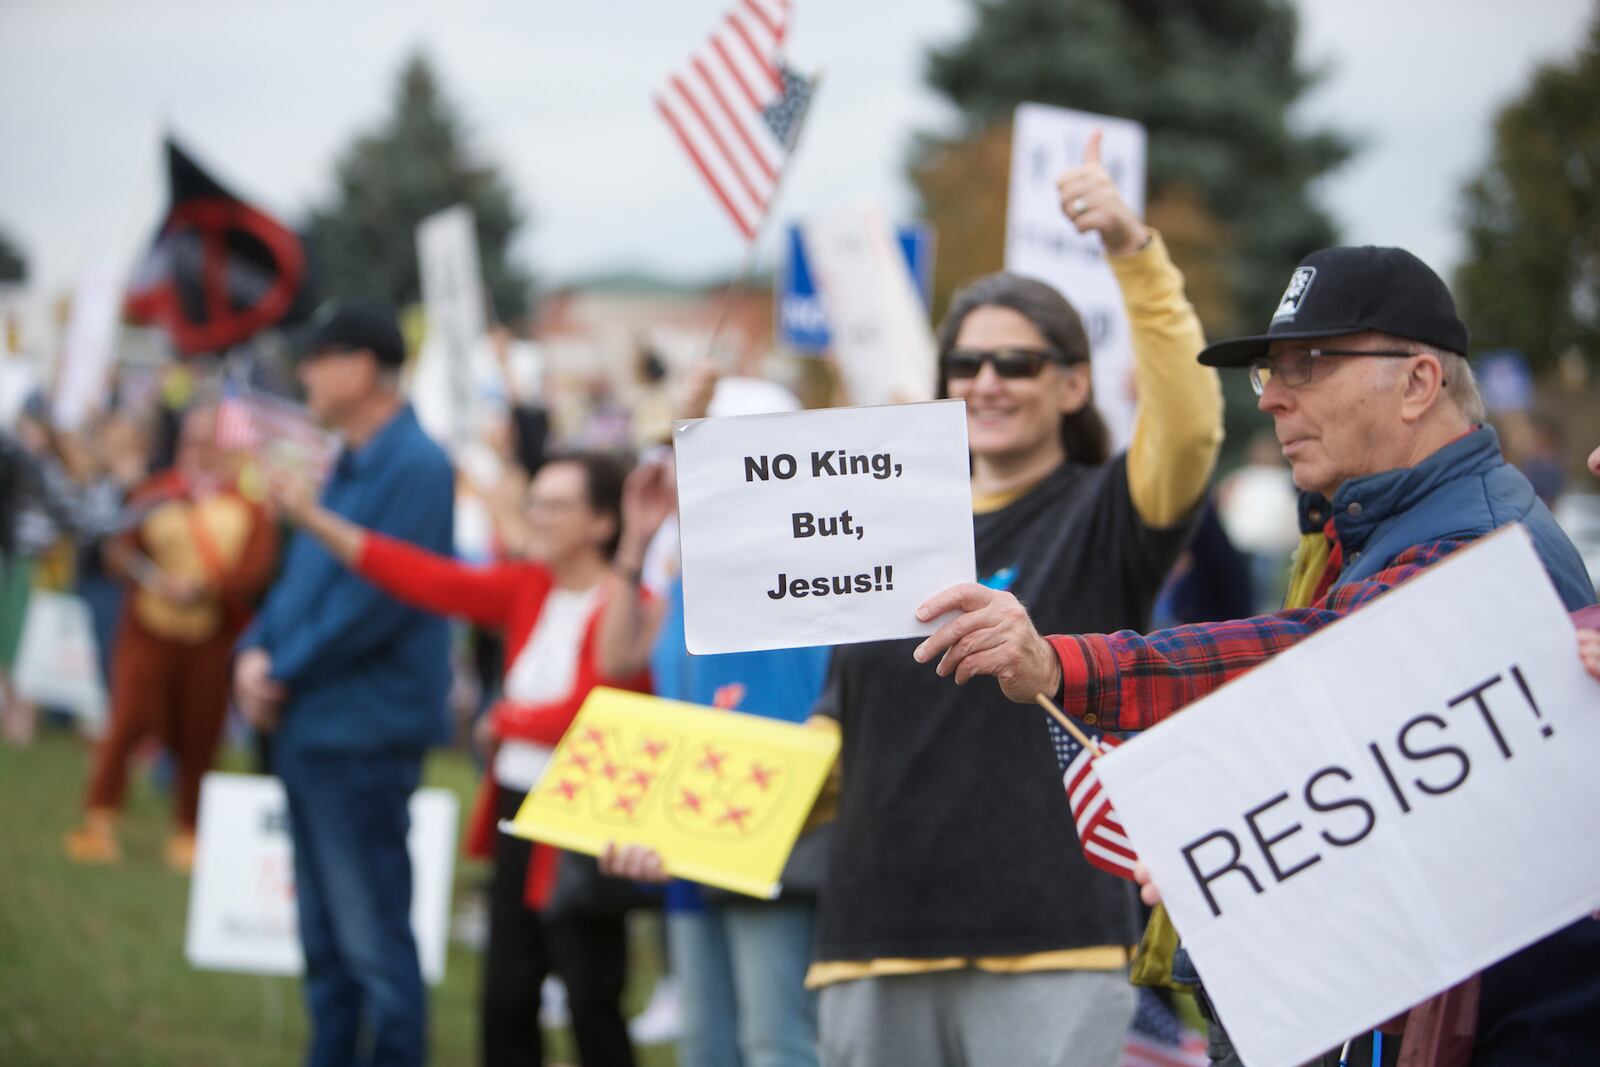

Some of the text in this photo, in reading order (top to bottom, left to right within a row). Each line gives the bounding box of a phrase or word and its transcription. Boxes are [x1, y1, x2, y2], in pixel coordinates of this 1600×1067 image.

[743, 449, 903, 483] NO King,
[791, 509, 864, 541] But,
[766, 565, 894, 600] Jesus!!
[1180, 664, 1555, 918] RESIST!
